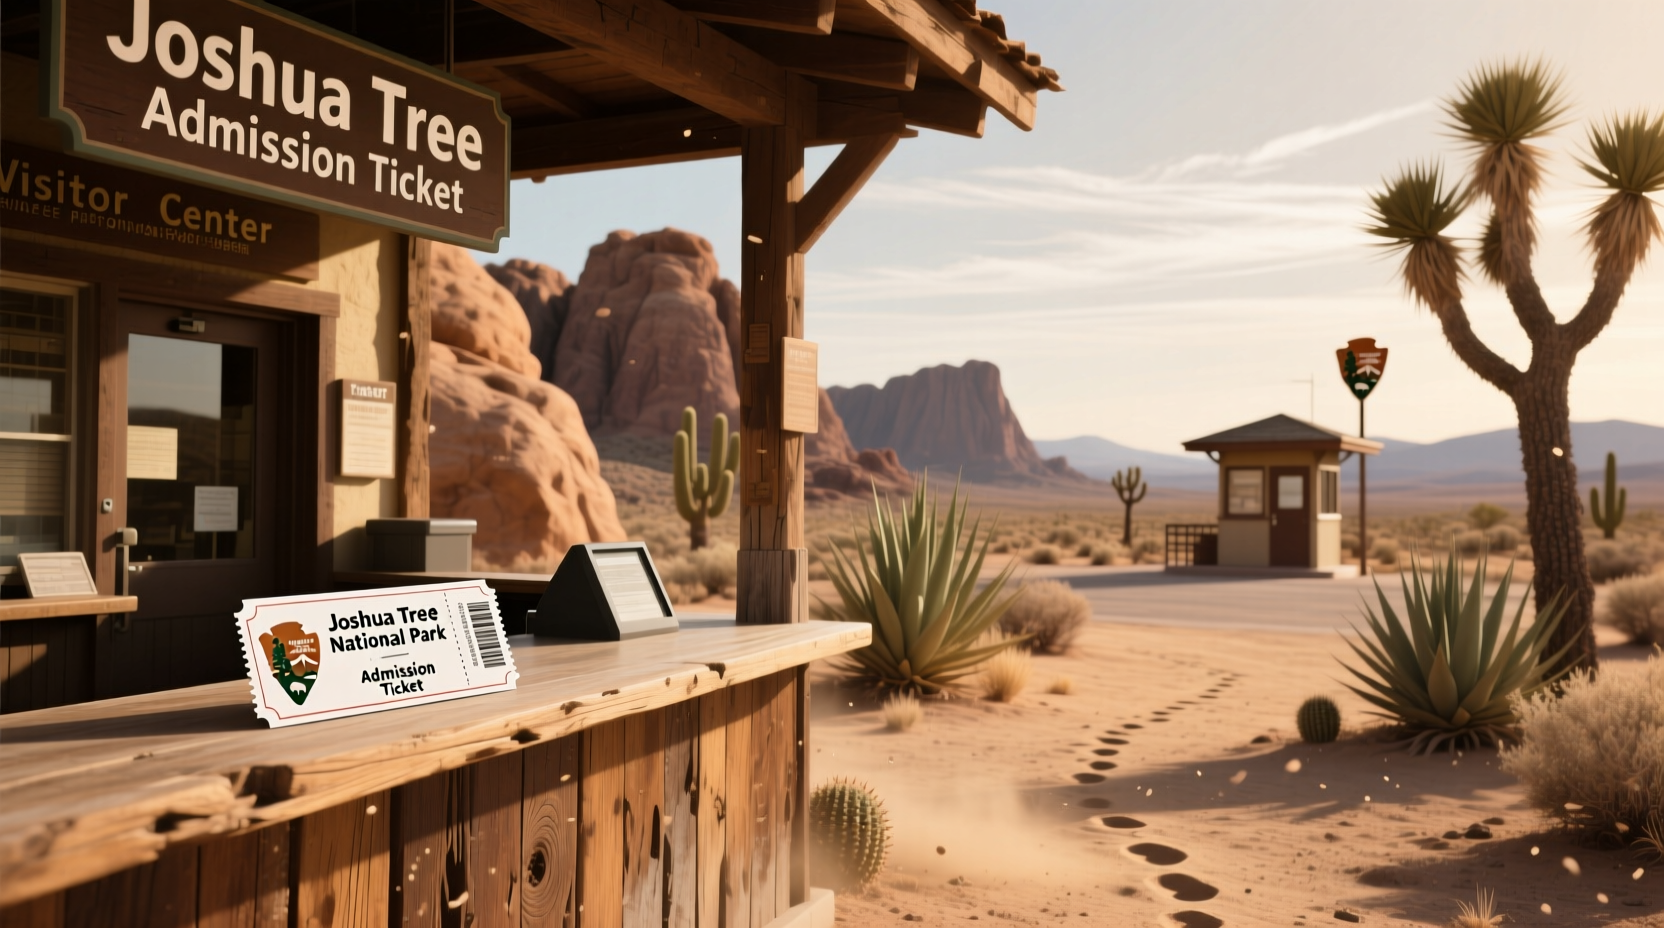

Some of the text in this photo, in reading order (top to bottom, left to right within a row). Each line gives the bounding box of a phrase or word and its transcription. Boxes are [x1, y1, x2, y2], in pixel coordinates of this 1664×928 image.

[106, 0, 483, 171] Joshua Tree
[141, 86, 464, 214] Admission Ticket
[0, 159, 128, 215] Visitor
[160, 193, 272, 243] Center
[328, 606, 438, 632] Joshua Tree
[329, 627, 406, 653] National
[409, 623, 447, 643] Park
[361, 661, 436, 684] Admission
[379, 679, 424, 696] Ticket
